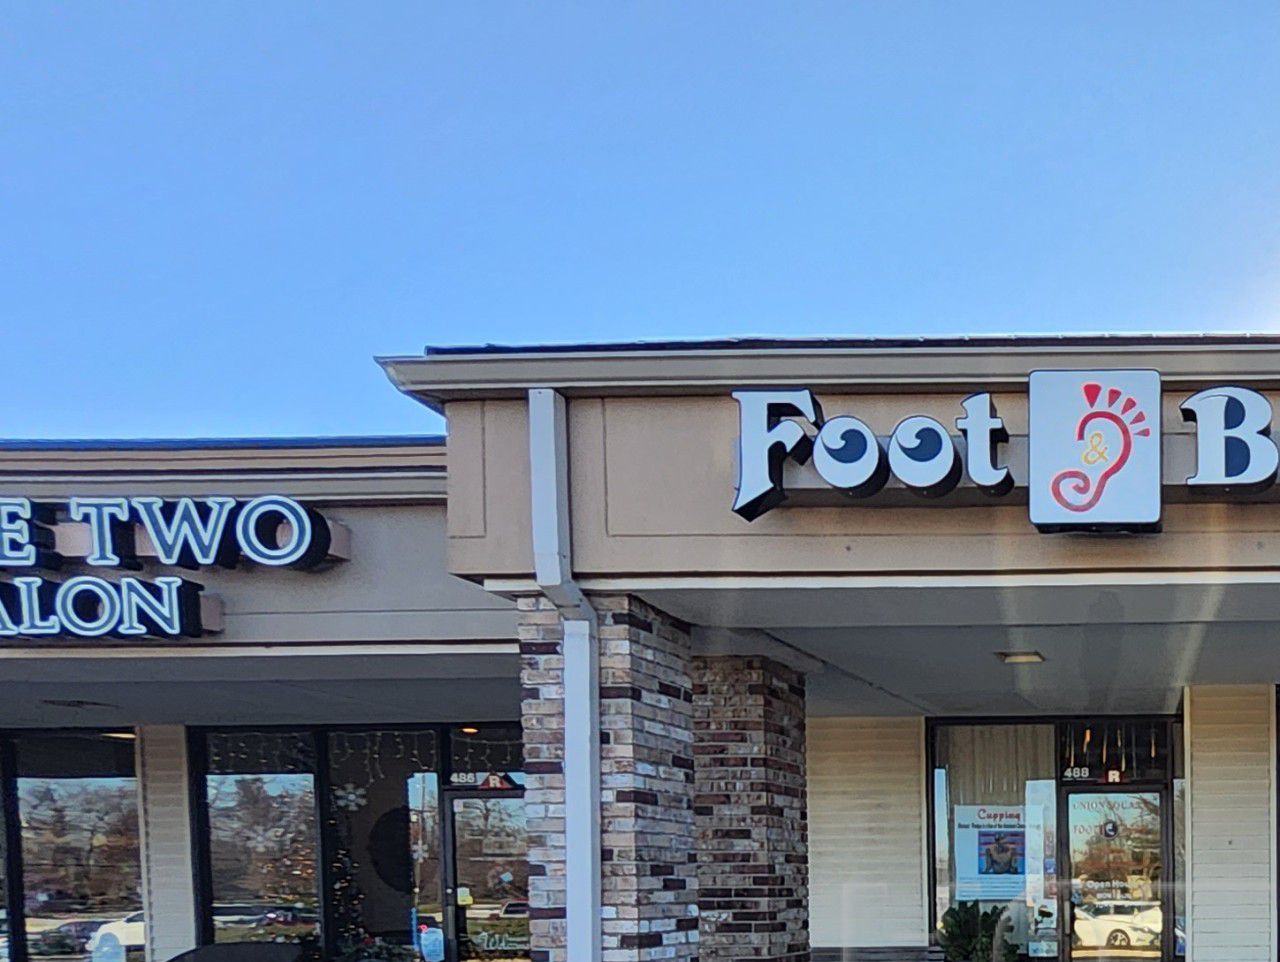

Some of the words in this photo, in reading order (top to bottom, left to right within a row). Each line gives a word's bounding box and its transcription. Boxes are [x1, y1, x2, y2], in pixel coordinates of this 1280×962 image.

[732, 388, 1010, 512] Foot
[69, 494, 312, 566] TWO
[1063, 767, 1090, 778] 488
[1107, 769, 1121, 783] R
[488, 775, 501, 788] R
